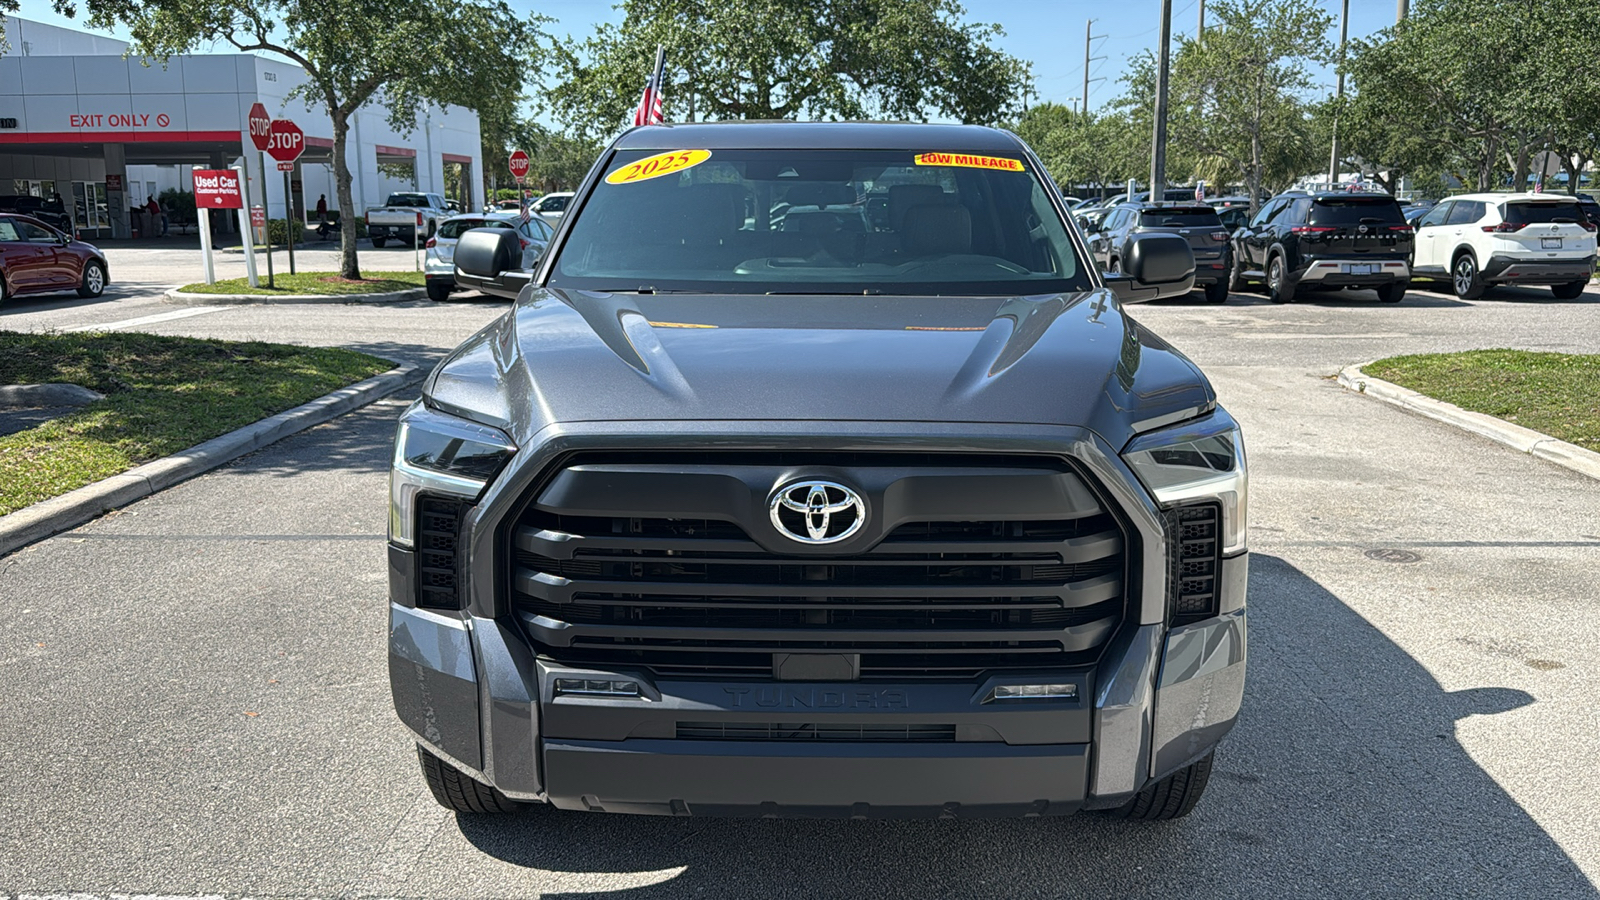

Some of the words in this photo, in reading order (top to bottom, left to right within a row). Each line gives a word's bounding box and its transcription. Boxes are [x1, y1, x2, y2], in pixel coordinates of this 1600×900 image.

[70, 114, 103, 127] EXIT
[108, 114, 150, 127] ONLY
[250, 117, 270, 136] STOP
[511, 158, 528, 170] STOP
[624, 151, 693, 180] 2025
[920, 153, 952, 164] LOW
[954, 155, 1018, 170] MILEAGE
[195, 175, 219, 188] Used
[219, 176, 237, 188] Car
[219, 187, 239, 196] Parking
[723, 687, 909, 709] TUNDRA
